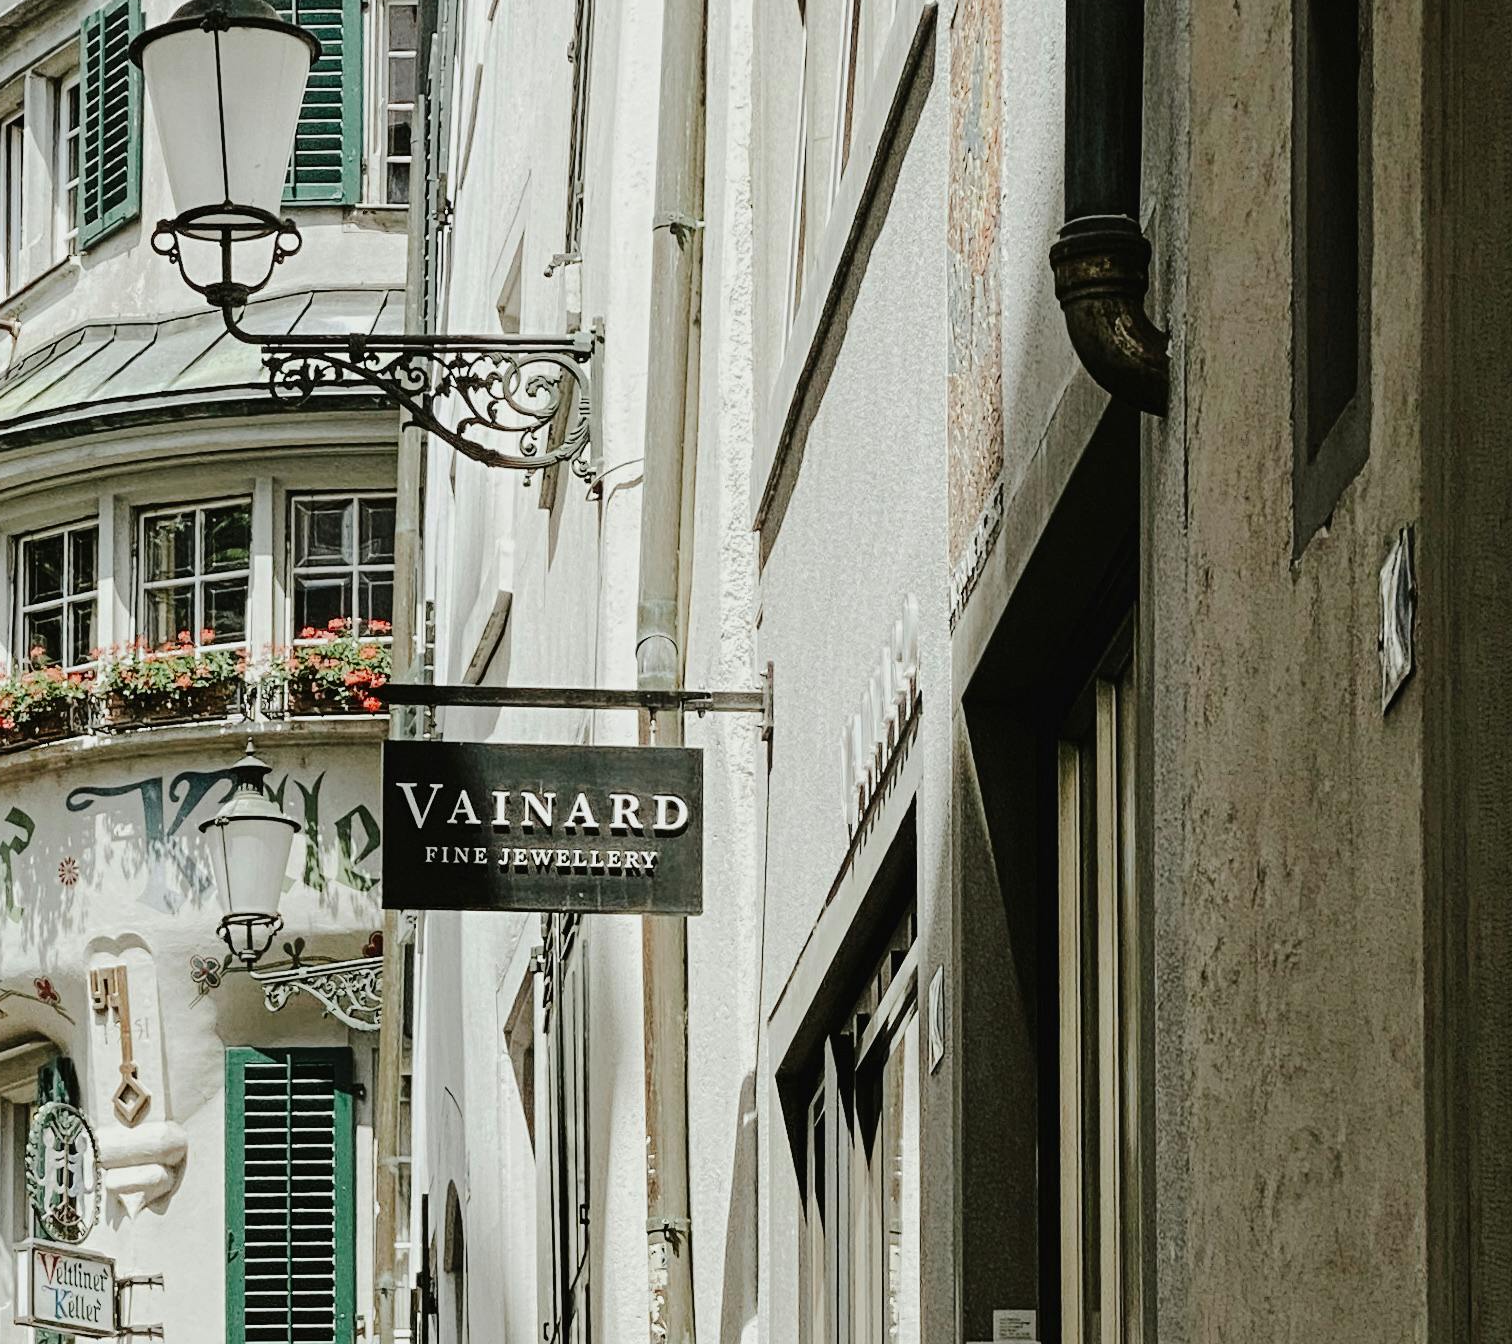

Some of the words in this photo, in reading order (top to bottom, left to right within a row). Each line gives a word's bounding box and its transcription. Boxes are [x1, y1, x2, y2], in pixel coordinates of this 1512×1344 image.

[395, 782, 689, 831] VAINARD
[425, 846, 488, 865] FINE
[498, 847, 658, 870] JEWELLERY
[38, 1252, 109, 1293] Veltliner
[42, 1285, 102, 1323] Keller
